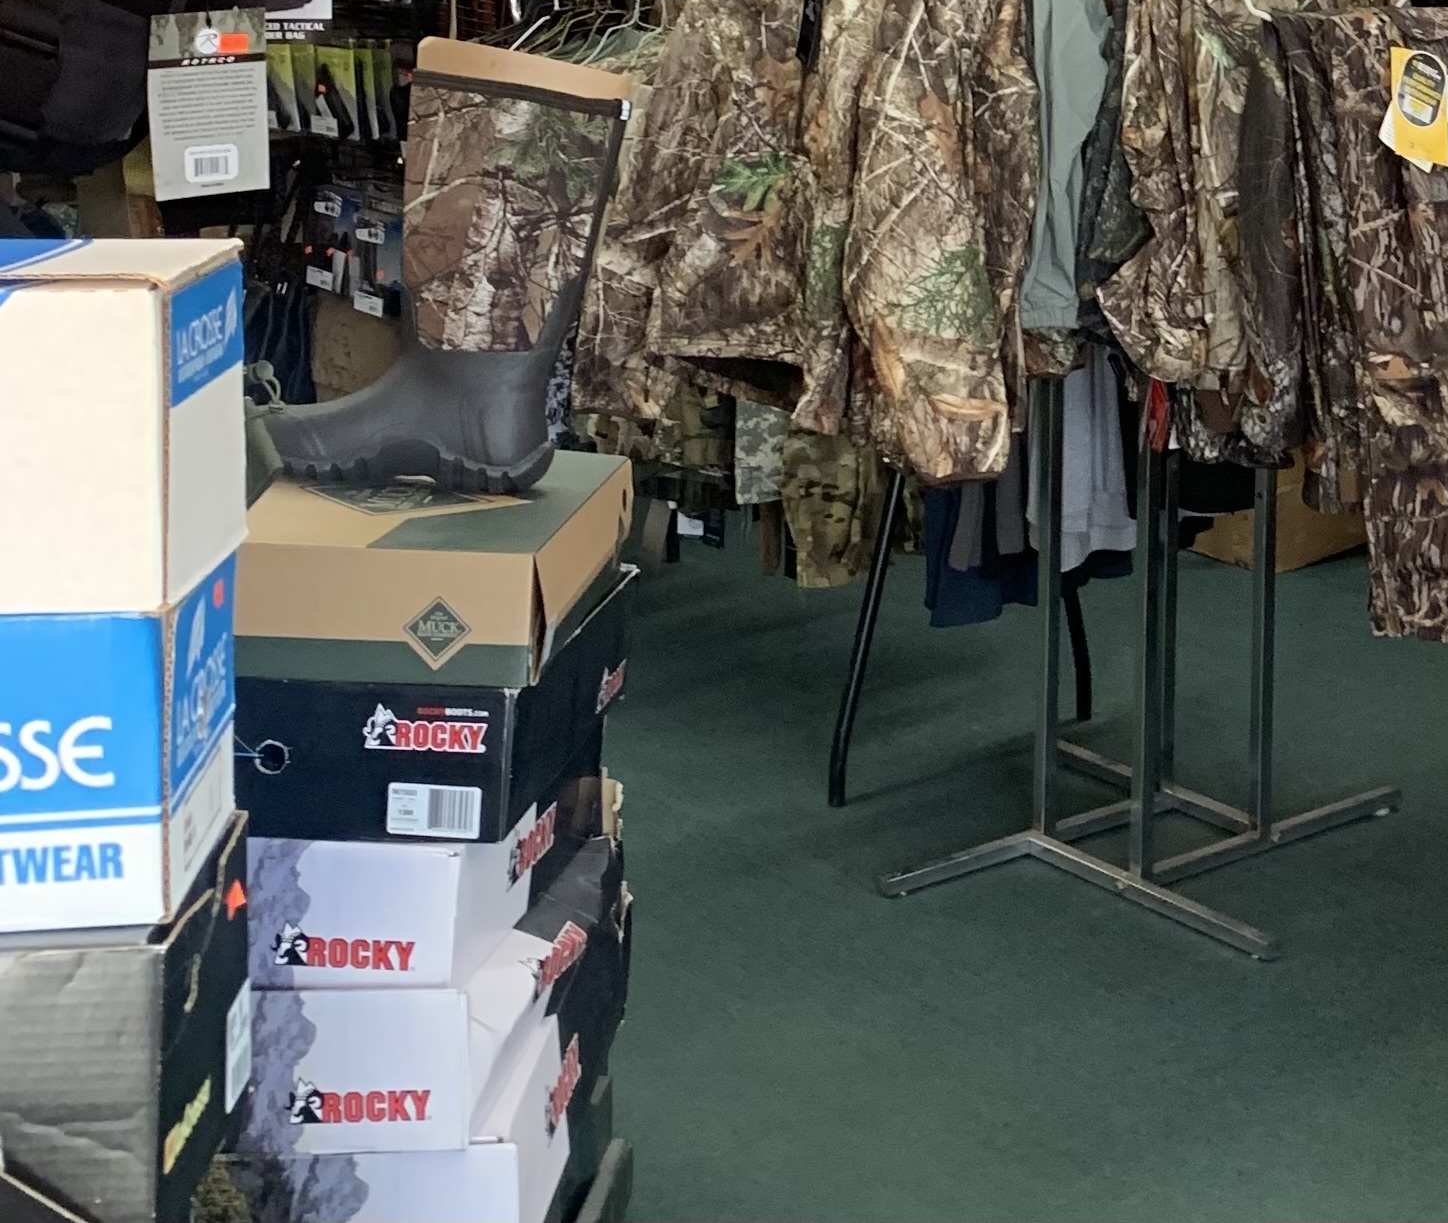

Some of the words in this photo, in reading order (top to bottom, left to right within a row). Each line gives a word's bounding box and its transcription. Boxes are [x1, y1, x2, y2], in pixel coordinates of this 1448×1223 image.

[282, 22, 325, 31] TACTICAL
[284, 31, 306, 40] BAG
[418, 620, 461, 634] MUCK
[394, 720, 488, 753] ROCKY
[306, 936, 416, 972] ROCKY
[320, 1089, 432, 1124] ROCKY
